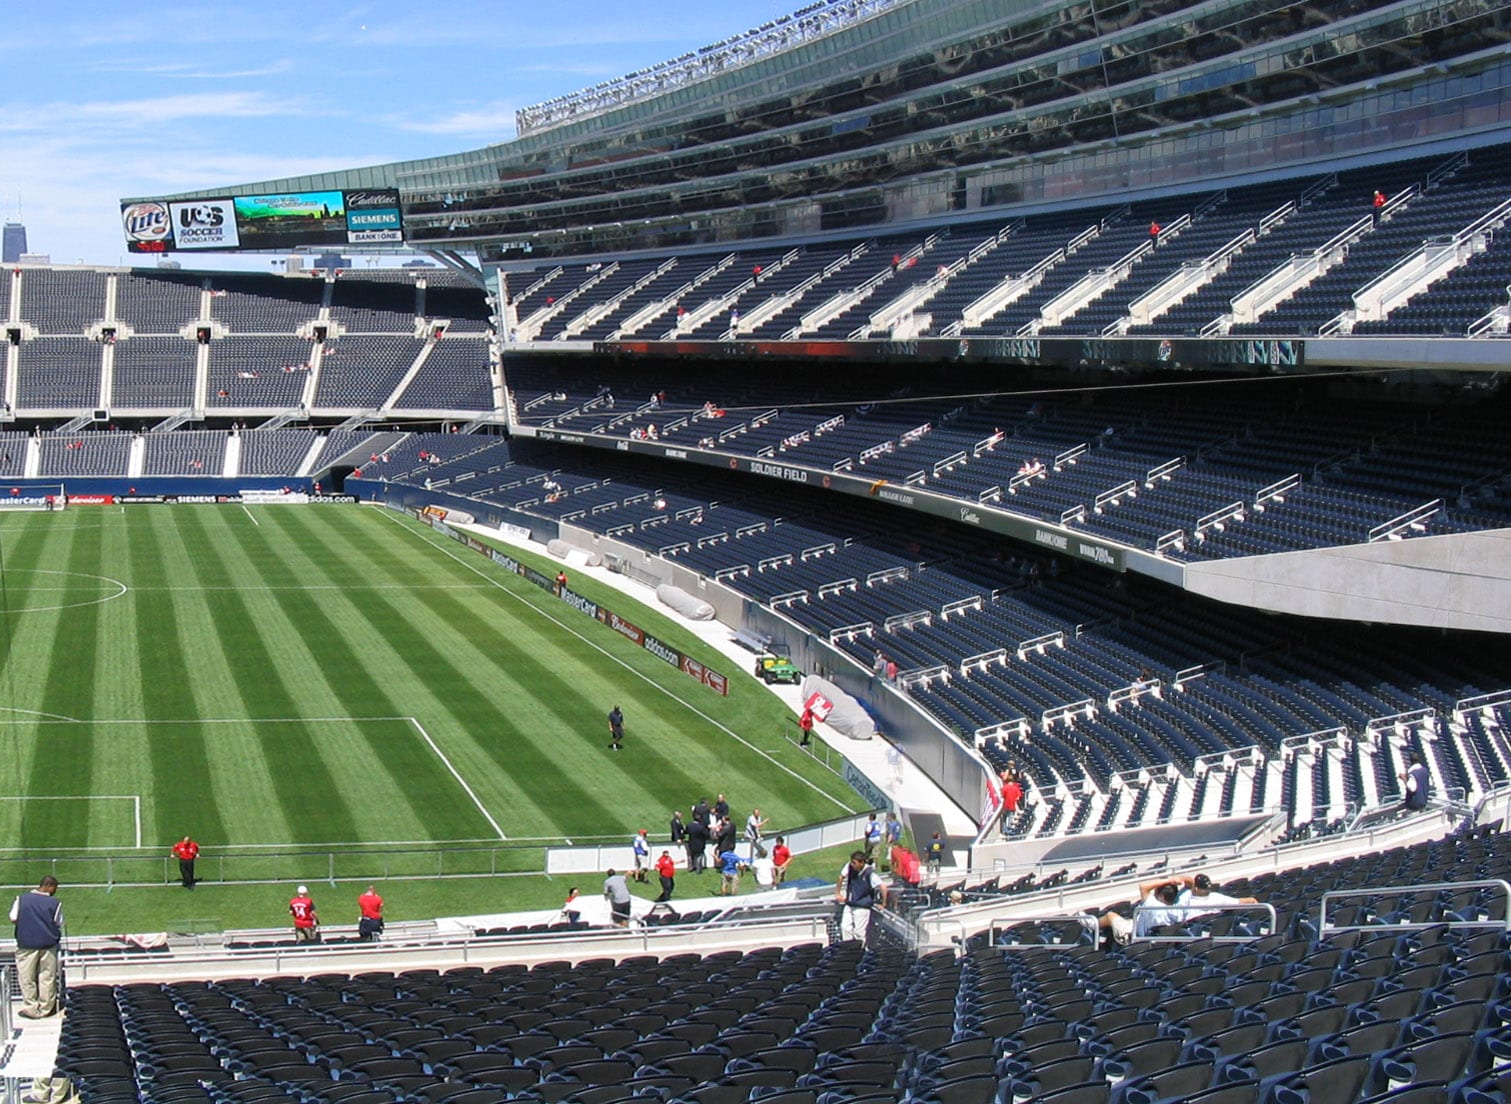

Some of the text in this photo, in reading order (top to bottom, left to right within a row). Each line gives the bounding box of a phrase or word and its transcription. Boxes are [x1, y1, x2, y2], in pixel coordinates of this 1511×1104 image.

[346, 192, 396, 207] Cadillac
[351, 214, 396, 224] SIEMENS
[180, 228, 223, 237] SOCCER
[355, 232, 398, 241] BANK ONE
[179, 235, 223, 244] FOUNDATION
[750, 462, 807, 482] SOLDIER FIELD
[177, 495, 216, 503] SIEMENS
[560, 586, 597, 618] MasterCard
[644, 637, 680, 668] adidas.com
